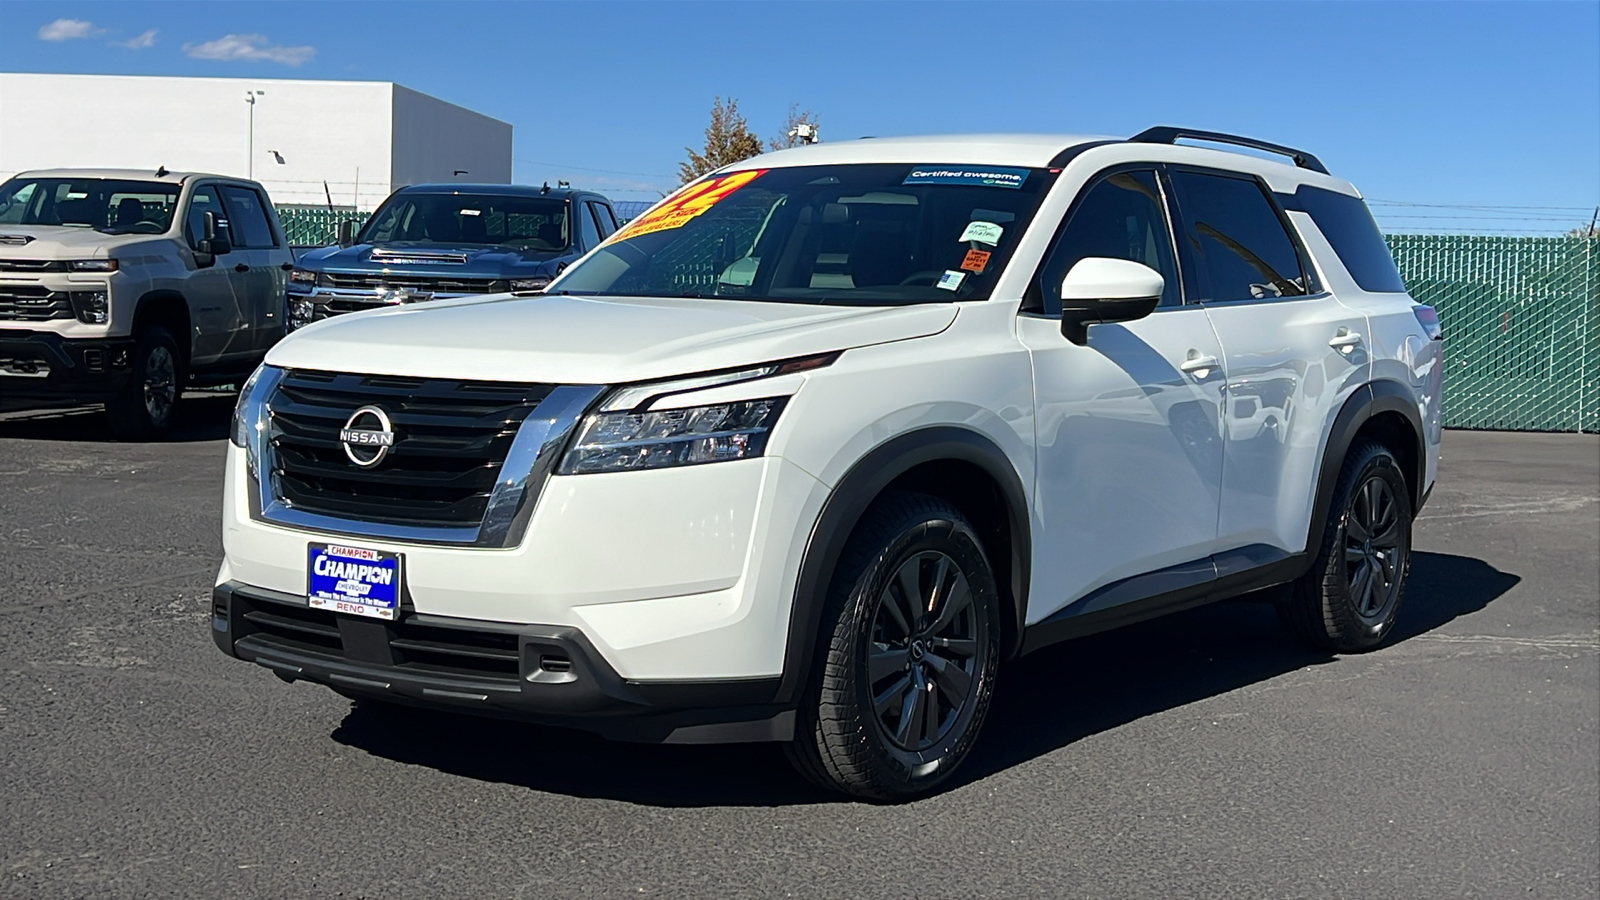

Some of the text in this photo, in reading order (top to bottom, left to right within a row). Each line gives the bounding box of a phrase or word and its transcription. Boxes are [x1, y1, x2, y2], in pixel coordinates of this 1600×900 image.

[963, 172, 1022, 181] awesome.
[643, 170, 758, 220] 22
[340, 430, 391, 444] NISSAN
[331, 546, 374, 559] CHAMPION
[314, 554, 393, 585] CHAMPION
[337, 582, 368, 593] CHEVROLET
[336, 602, 365, 614] RENO
